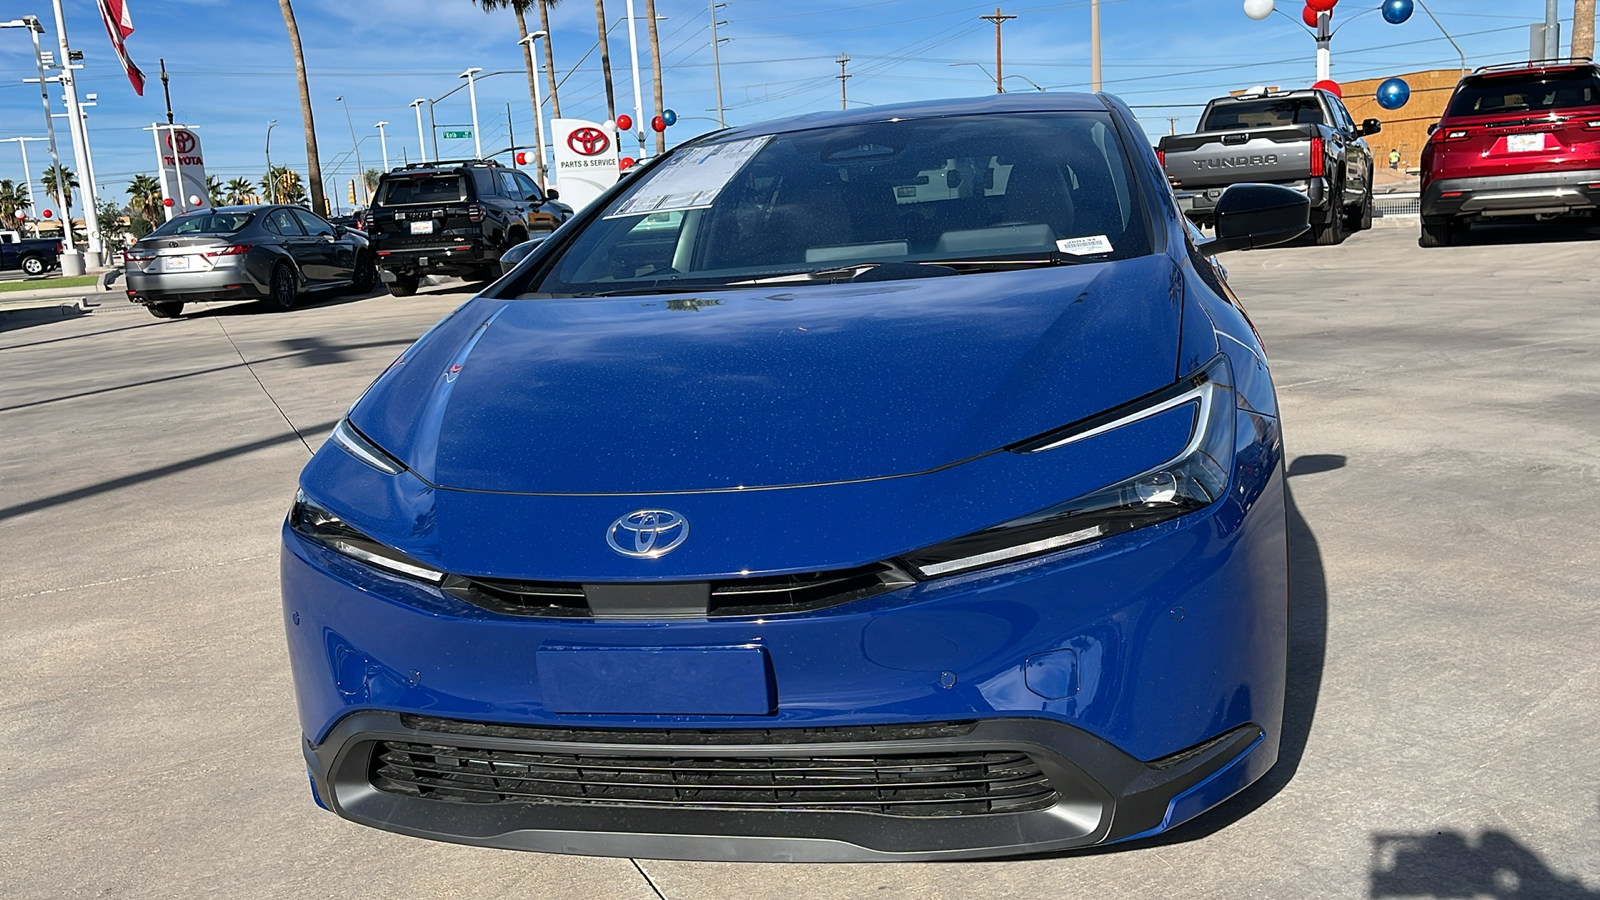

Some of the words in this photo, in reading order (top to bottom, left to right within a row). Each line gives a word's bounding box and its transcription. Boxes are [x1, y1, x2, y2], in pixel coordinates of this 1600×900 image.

[163, 156, 204, 166] TOYOTA
[590, 159, 616, 167] SERVICE
[1193, 154, 1278, 170] TUNDRA
